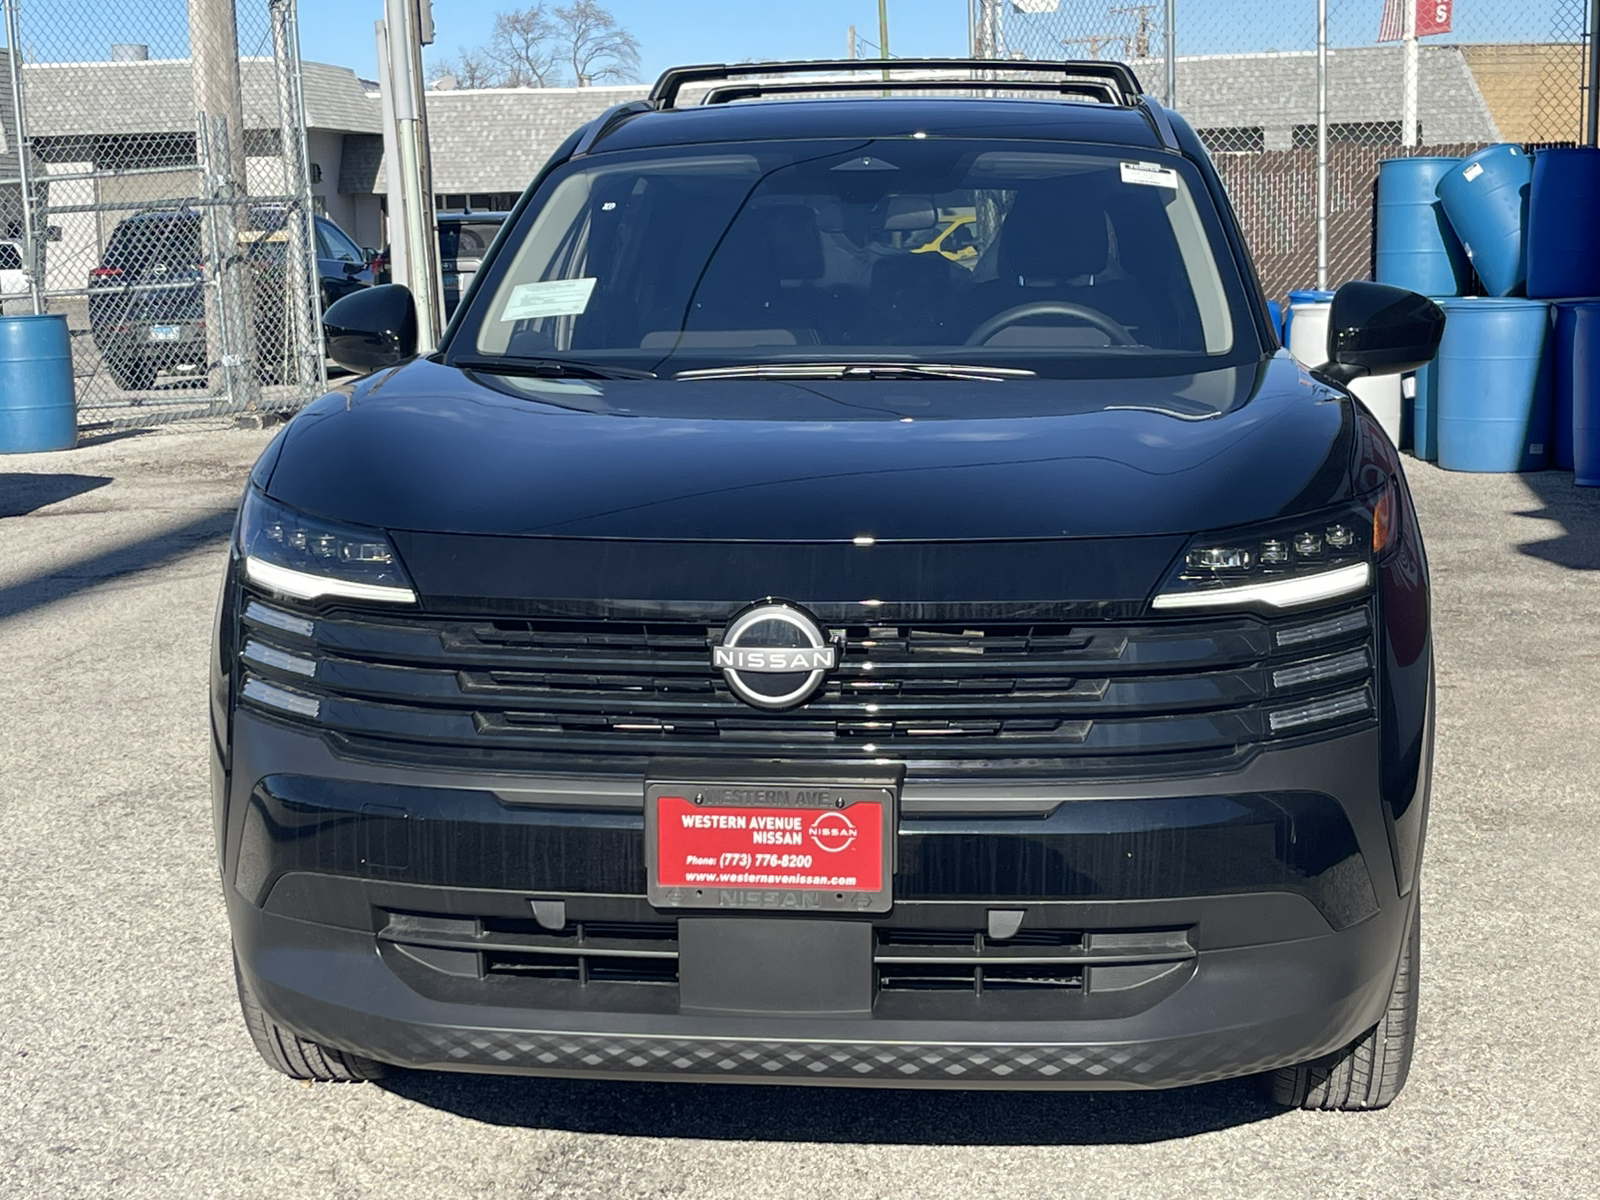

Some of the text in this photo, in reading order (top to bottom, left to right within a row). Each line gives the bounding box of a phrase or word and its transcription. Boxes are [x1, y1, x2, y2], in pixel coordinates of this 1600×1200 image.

[716, 650, 832, 668] NISSAN
[704, 788, 790, 806] WESTERN
[681, 814, 803, 830] WESTERN AVENUE
[752, 830, 803, 845] NISSAN
[808, 827, 858, 837] NISSAN
[685, 852, 813, 869] Phone: (773) 776-8200
[685, 872, 857, 886] www.westernavenissan.com
[719, 890, 820, 908] NISSAN
